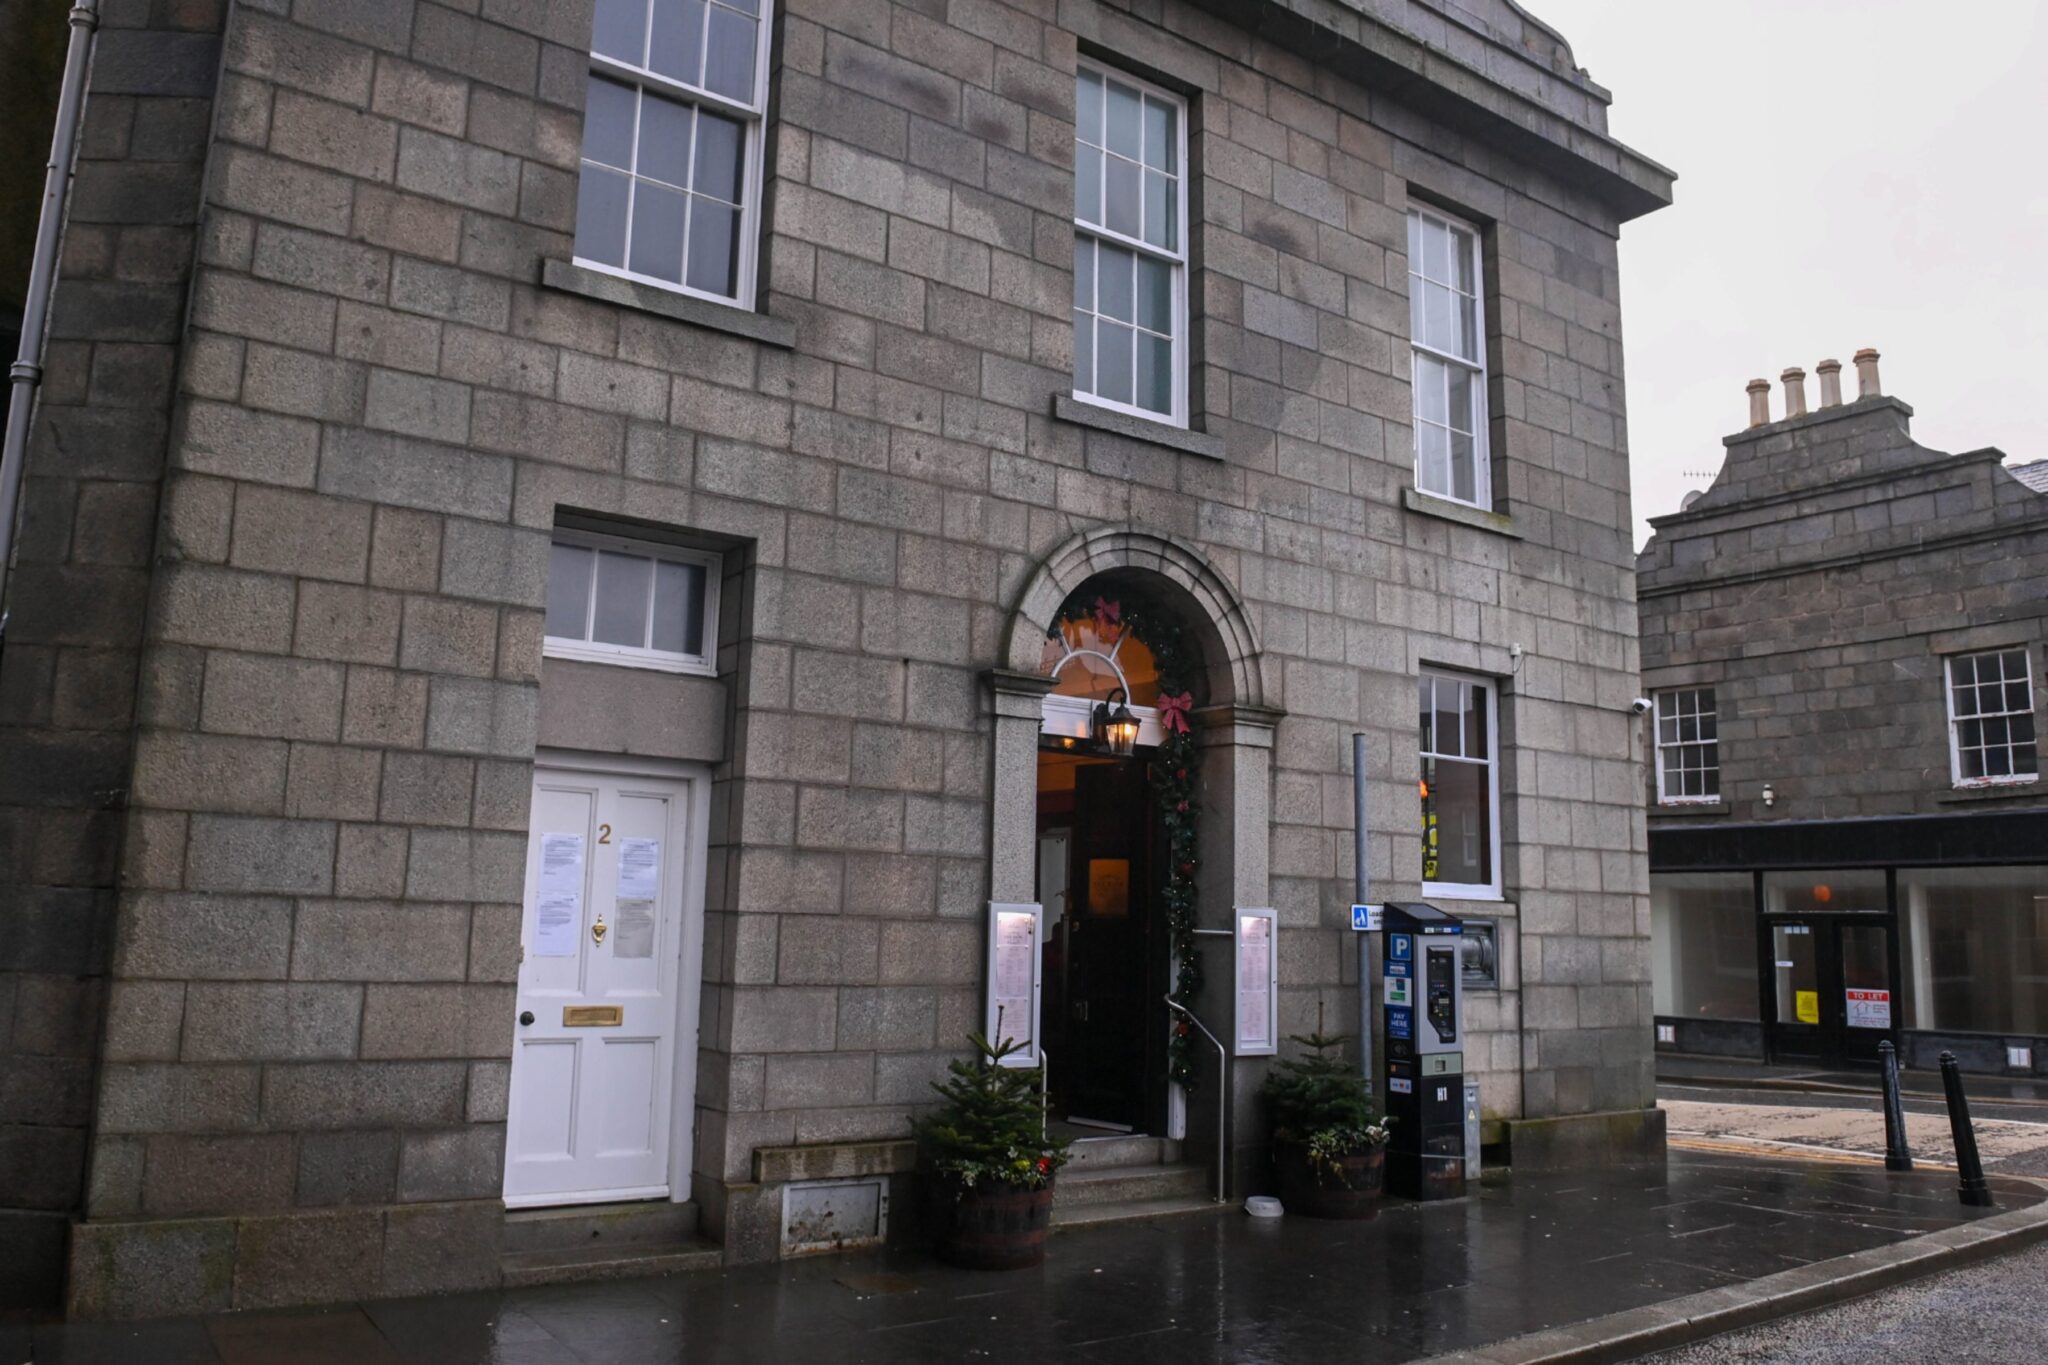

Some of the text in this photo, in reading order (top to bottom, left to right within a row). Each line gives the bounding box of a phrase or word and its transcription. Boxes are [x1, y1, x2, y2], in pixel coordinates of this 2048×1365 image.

[598, 824, 611, 844] 2
[1396, 938, 1408, 956] P
[1854, 992, 1882, 1001] TO LET
[1393, 1012, 1405, 1020] PAY
[1391, 1020, 1408, 1028] HERE
